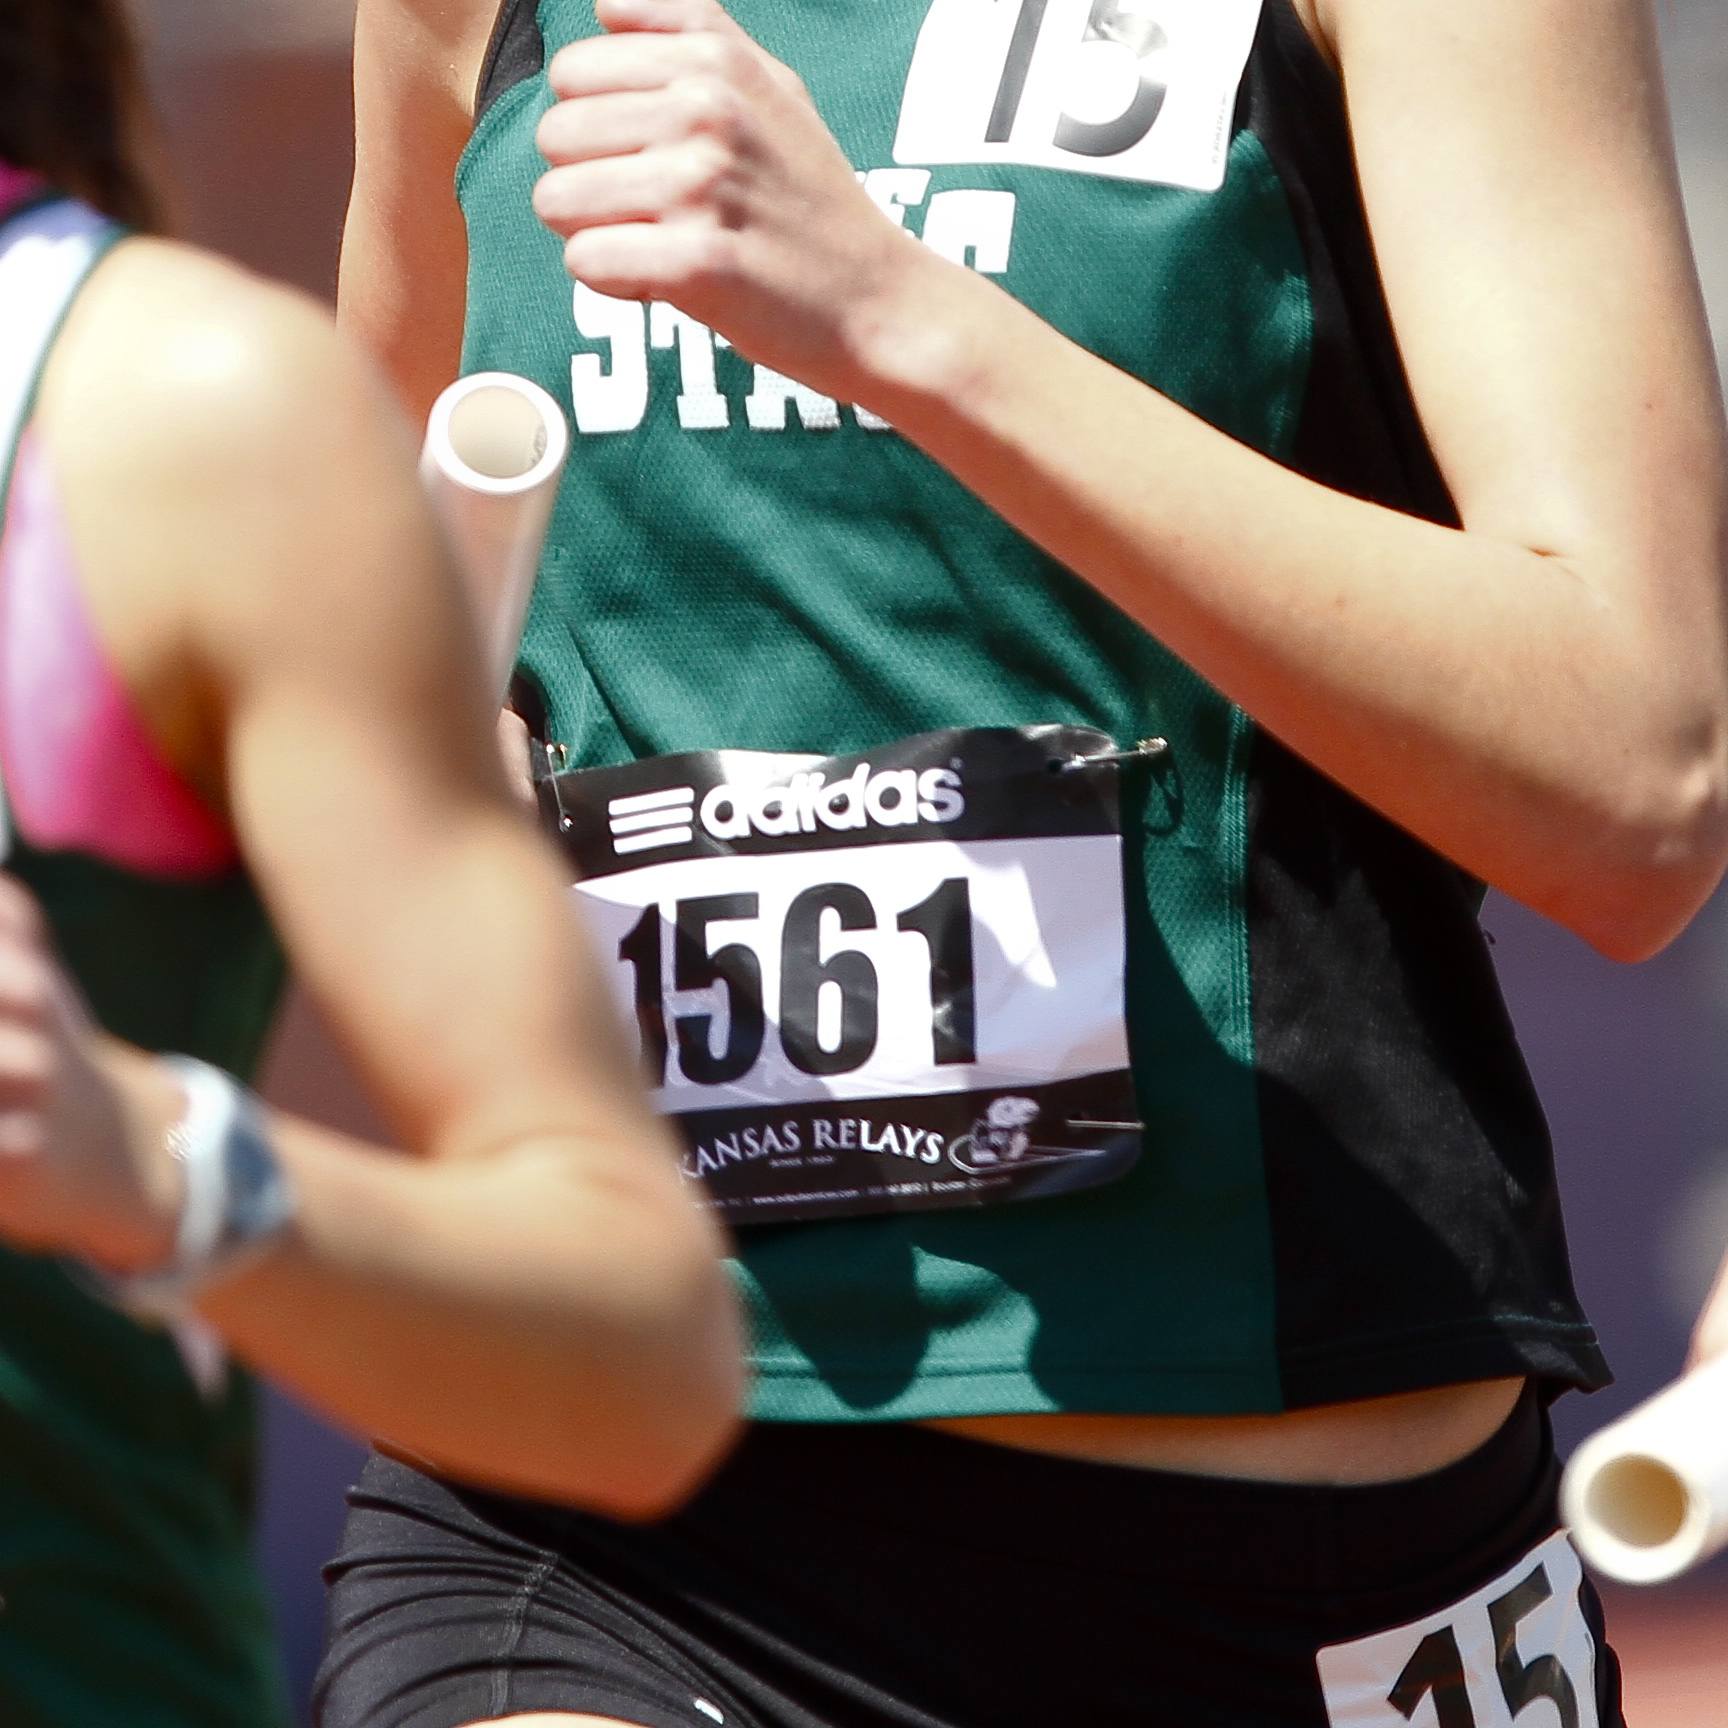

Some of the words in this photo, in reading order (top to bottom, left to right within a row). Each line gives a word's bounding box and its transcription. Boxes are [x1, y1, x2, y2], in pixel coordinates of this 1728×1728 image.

[699, 762, 966, 840] adidas
[616, 875, 977, 1088] 1561
[812, 1118, 944, 1165] RELAYS
